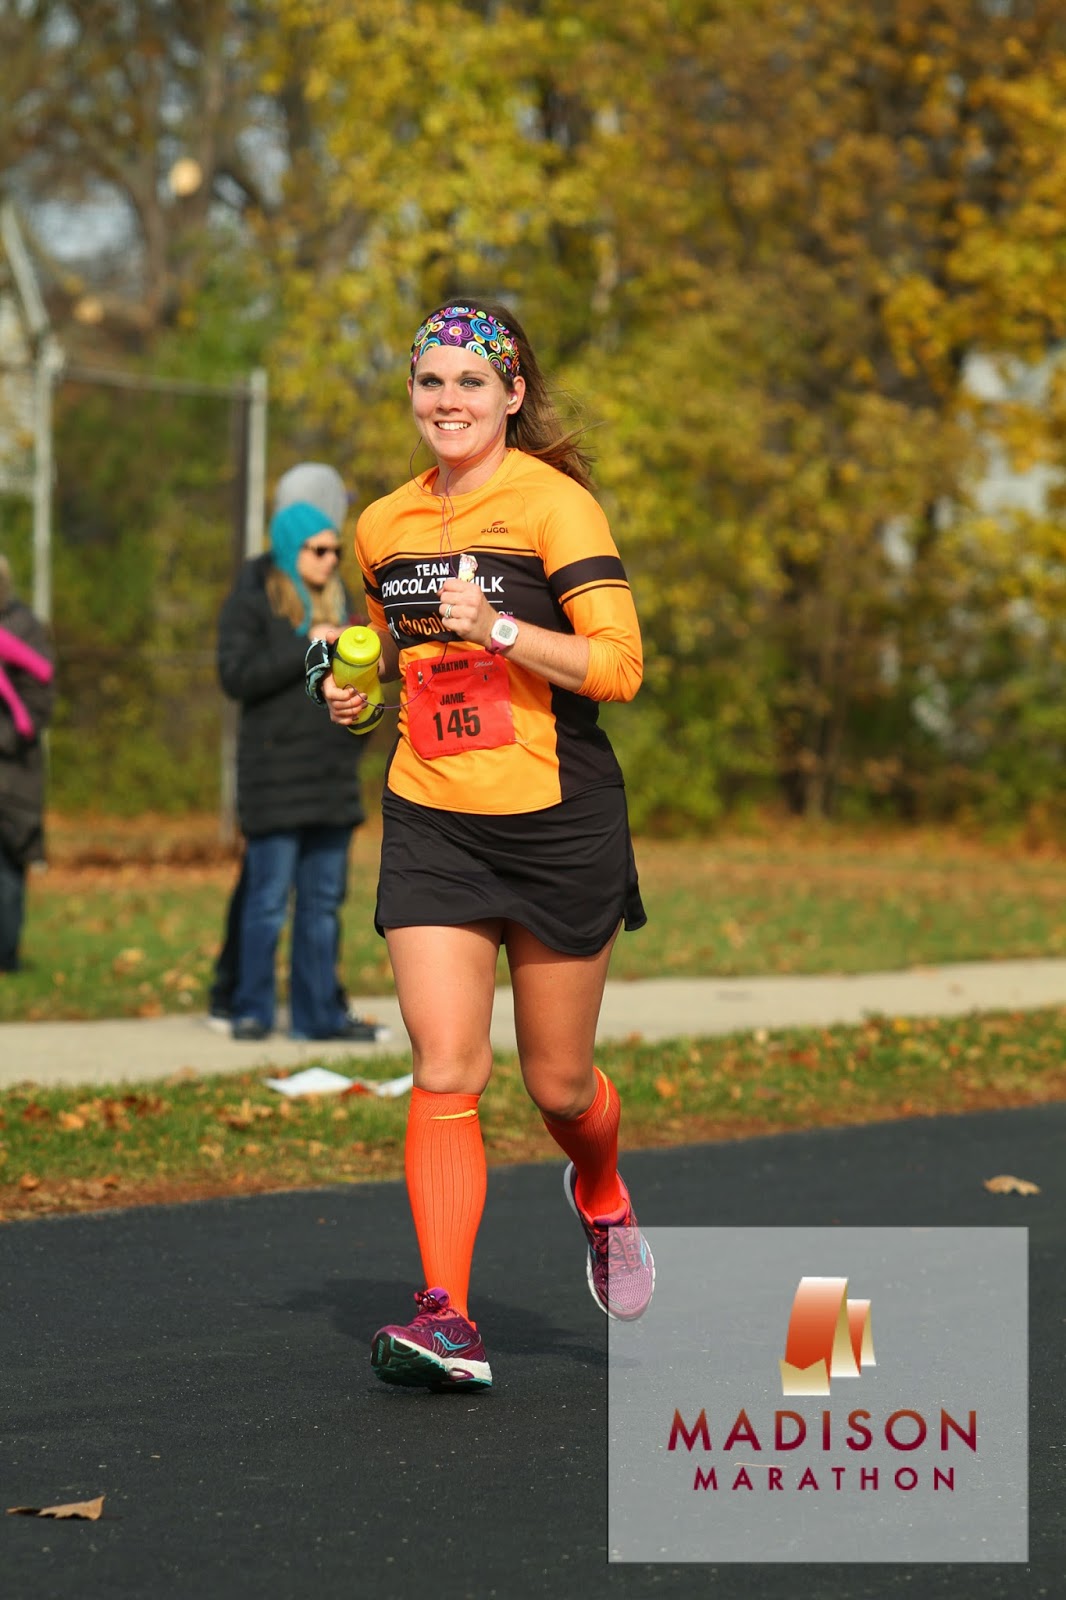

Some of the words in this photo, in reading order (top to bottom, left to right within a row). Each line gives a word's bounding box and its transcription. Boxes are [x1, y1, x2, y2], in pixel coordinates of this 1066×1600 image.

[415, 562, 450, 577] TEAM
[381, 577, 457, 598] CHOCOLAT
[398, 612, 451, 636] chocol
[430, 660, 469, 675] MARATHON
[440, 692, 466, 706] JAMIE
[433, 706, 481, 741] 145
